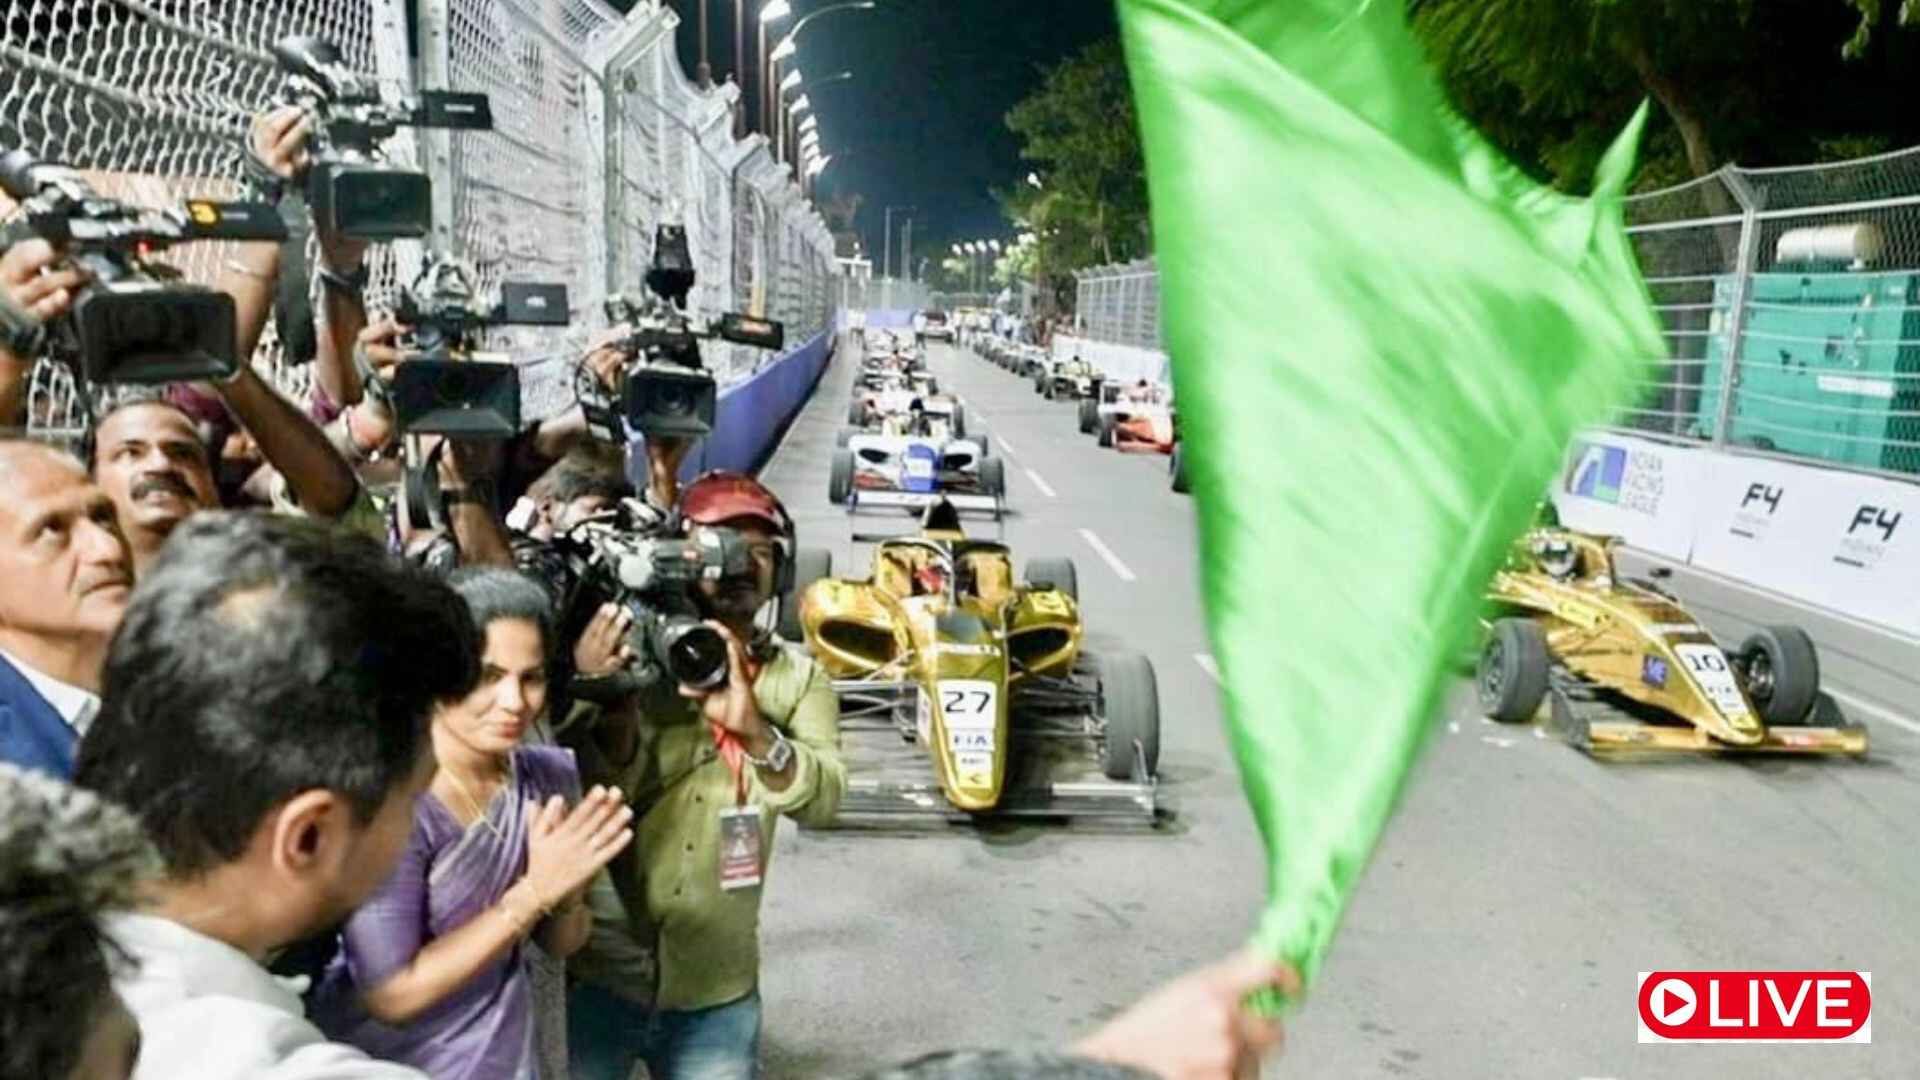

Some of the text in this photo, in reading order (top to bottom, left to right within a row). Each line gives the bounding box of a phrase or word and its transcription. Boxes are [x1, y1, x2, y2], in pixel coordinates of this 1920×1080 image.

[1740, 482, 1784, 515] F4
[1847, 505, 1903, 541] F4
[1684, 654, 1726, 672] 10
[942, 690, 991, 714] 27
